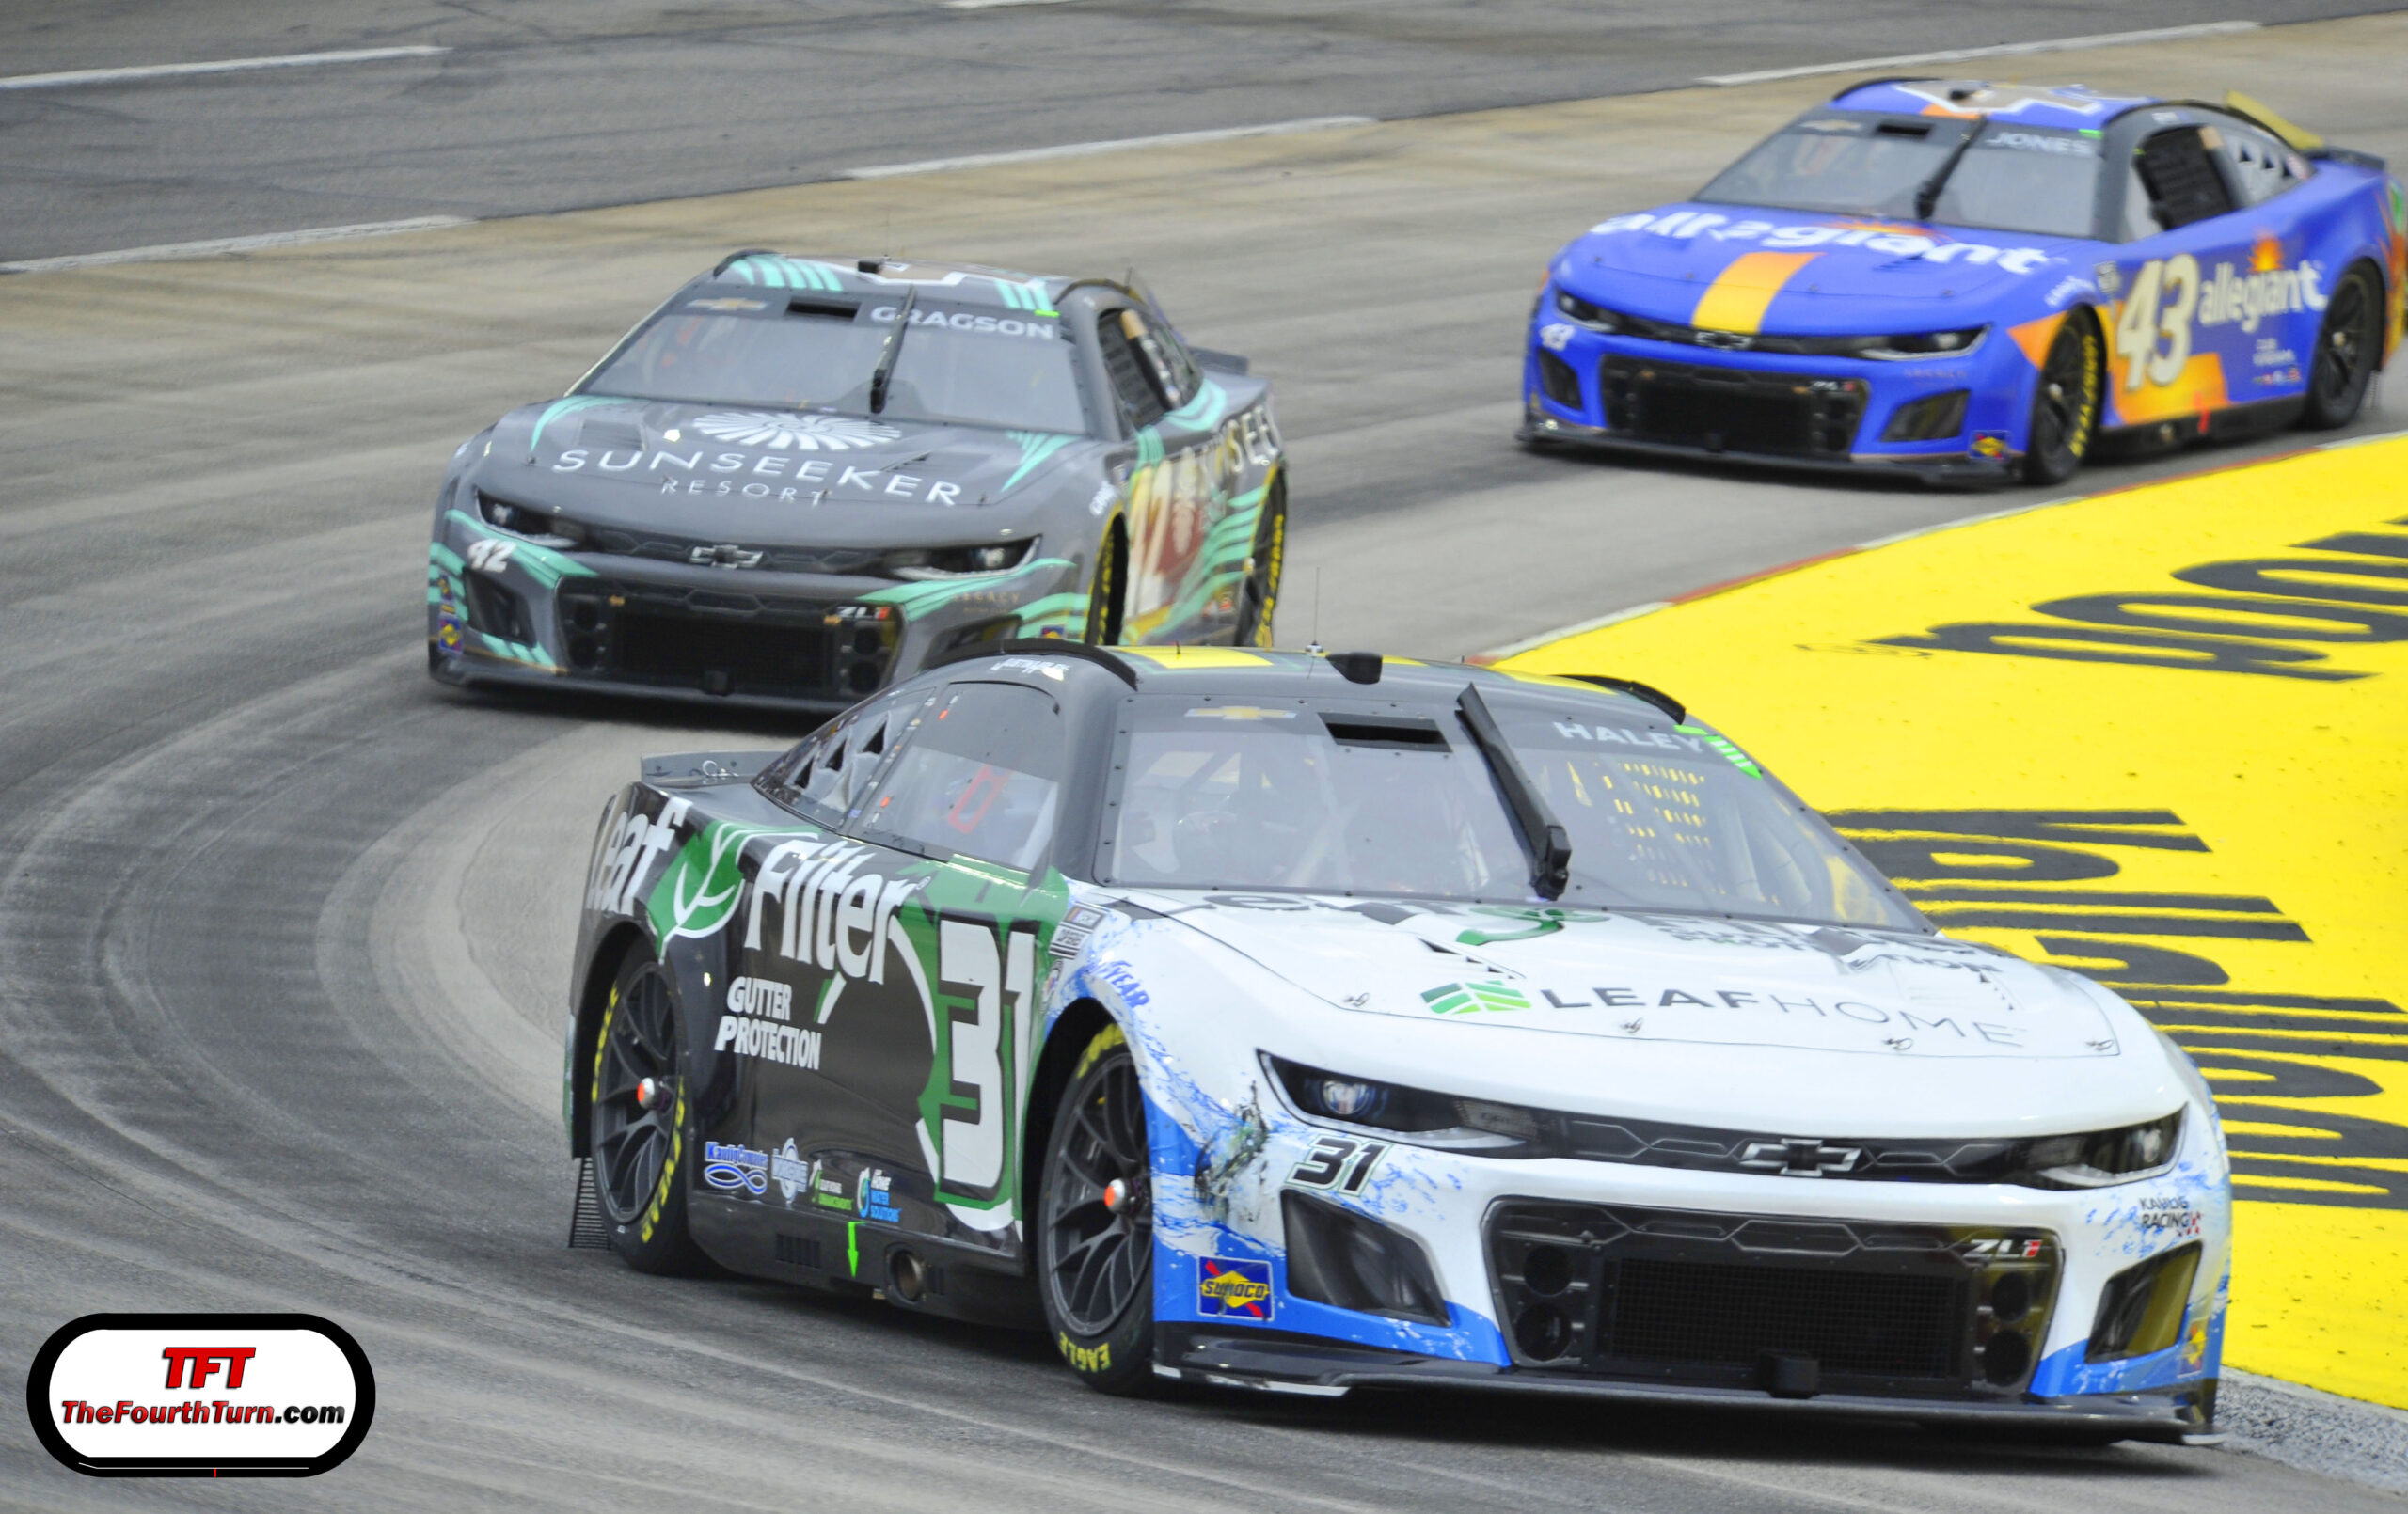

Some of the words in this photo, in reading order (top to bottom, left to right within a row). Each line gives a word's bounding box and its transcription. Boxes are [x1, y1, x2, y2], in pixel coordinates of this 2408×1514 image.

[1985, 132, 2093, 156] JONES
[1589, 212, 2052, 275] allegiant
[2198, 260, 2327, 333] allegiant
[870, 306, 1054, 339] GRAGSON
[2117, 253, 2199, 392] 43
[552, 449, 961, 506] SUNSEEKER
[661, 480, 826, 507] RESORT
[467, 538, 517, 574] 42
[1553, 721, 1703, 752] HALEY
[726, 976, 793, 1021] GUTTER
[713, 1015, 822, 1070] PROTECTION
[940, 919, 1036, 1194] 31
[1291, 1137, 1388, 1192] 31
[2141, 1212, 2191, 1229] RACING
[1203, 1280, 1267, 1299] SUNOCO
